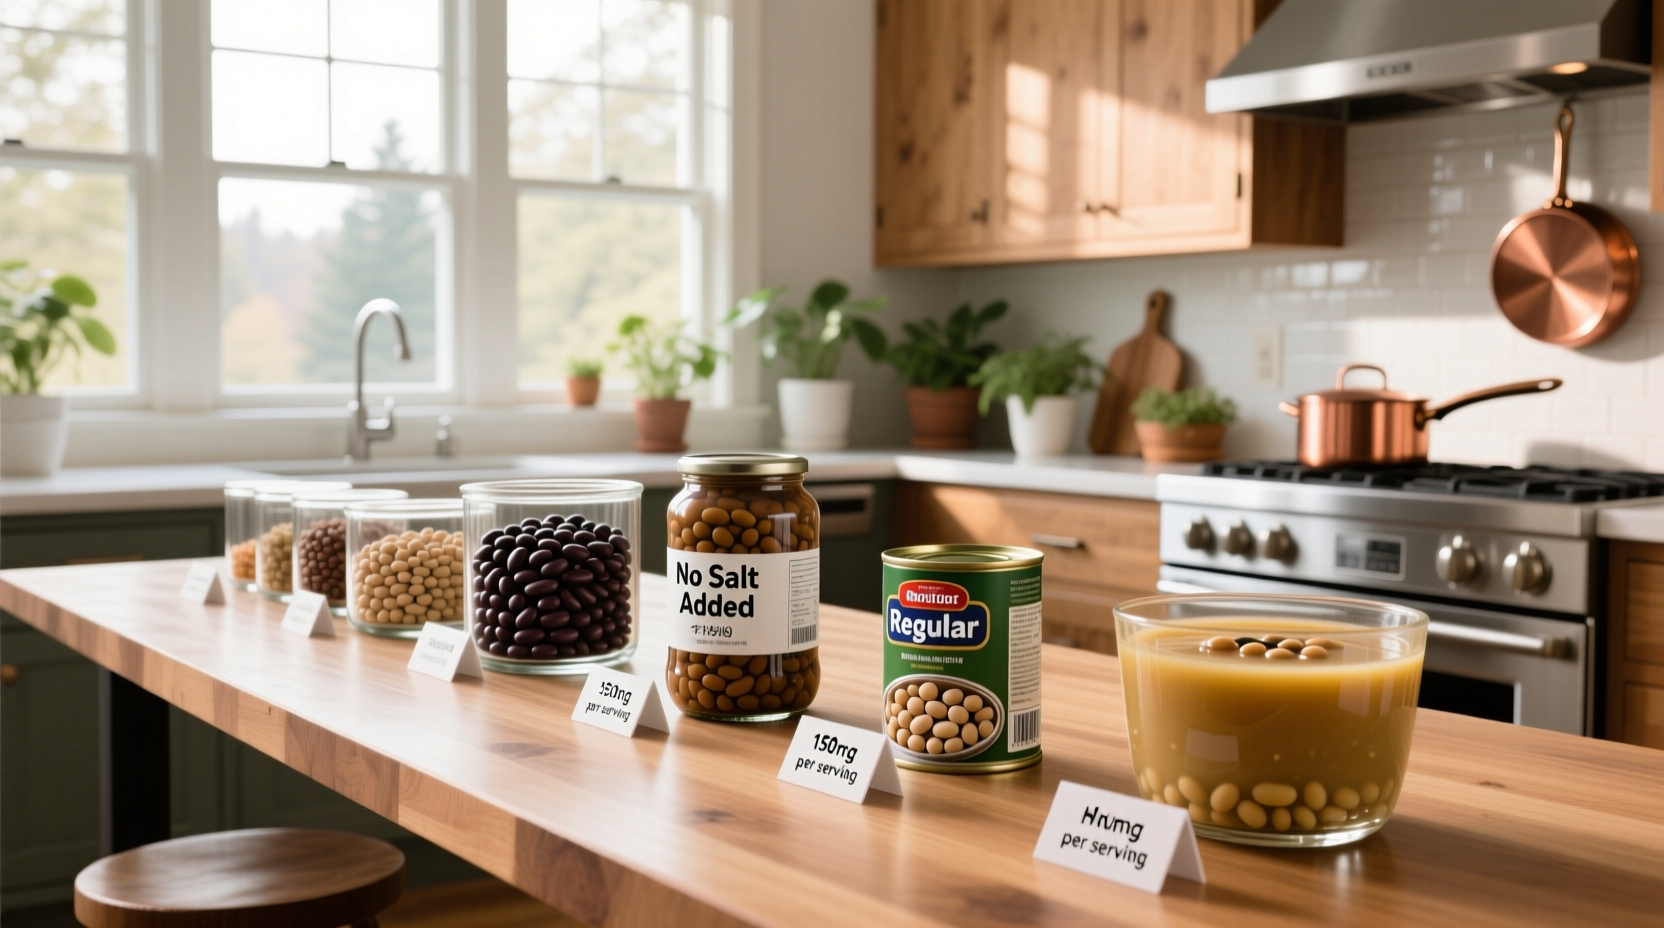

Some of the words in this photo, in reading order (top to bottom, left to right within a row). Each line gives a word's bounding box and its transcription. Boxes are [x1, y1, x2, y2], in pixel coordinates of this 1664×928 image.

[676, 562, 702, 586] No
[708, 564, 759, 589] Salt
[680, 591, 754, 618] Added
[890, 608, 979, 644] Regular
[813, 733, 858, 764] 150mg
[795, 756, 816, 771] per
[817, 762, 858, 785] serving
[1060, 832, 1088, 849] per
[1089, 840, 1147, 870] serving
